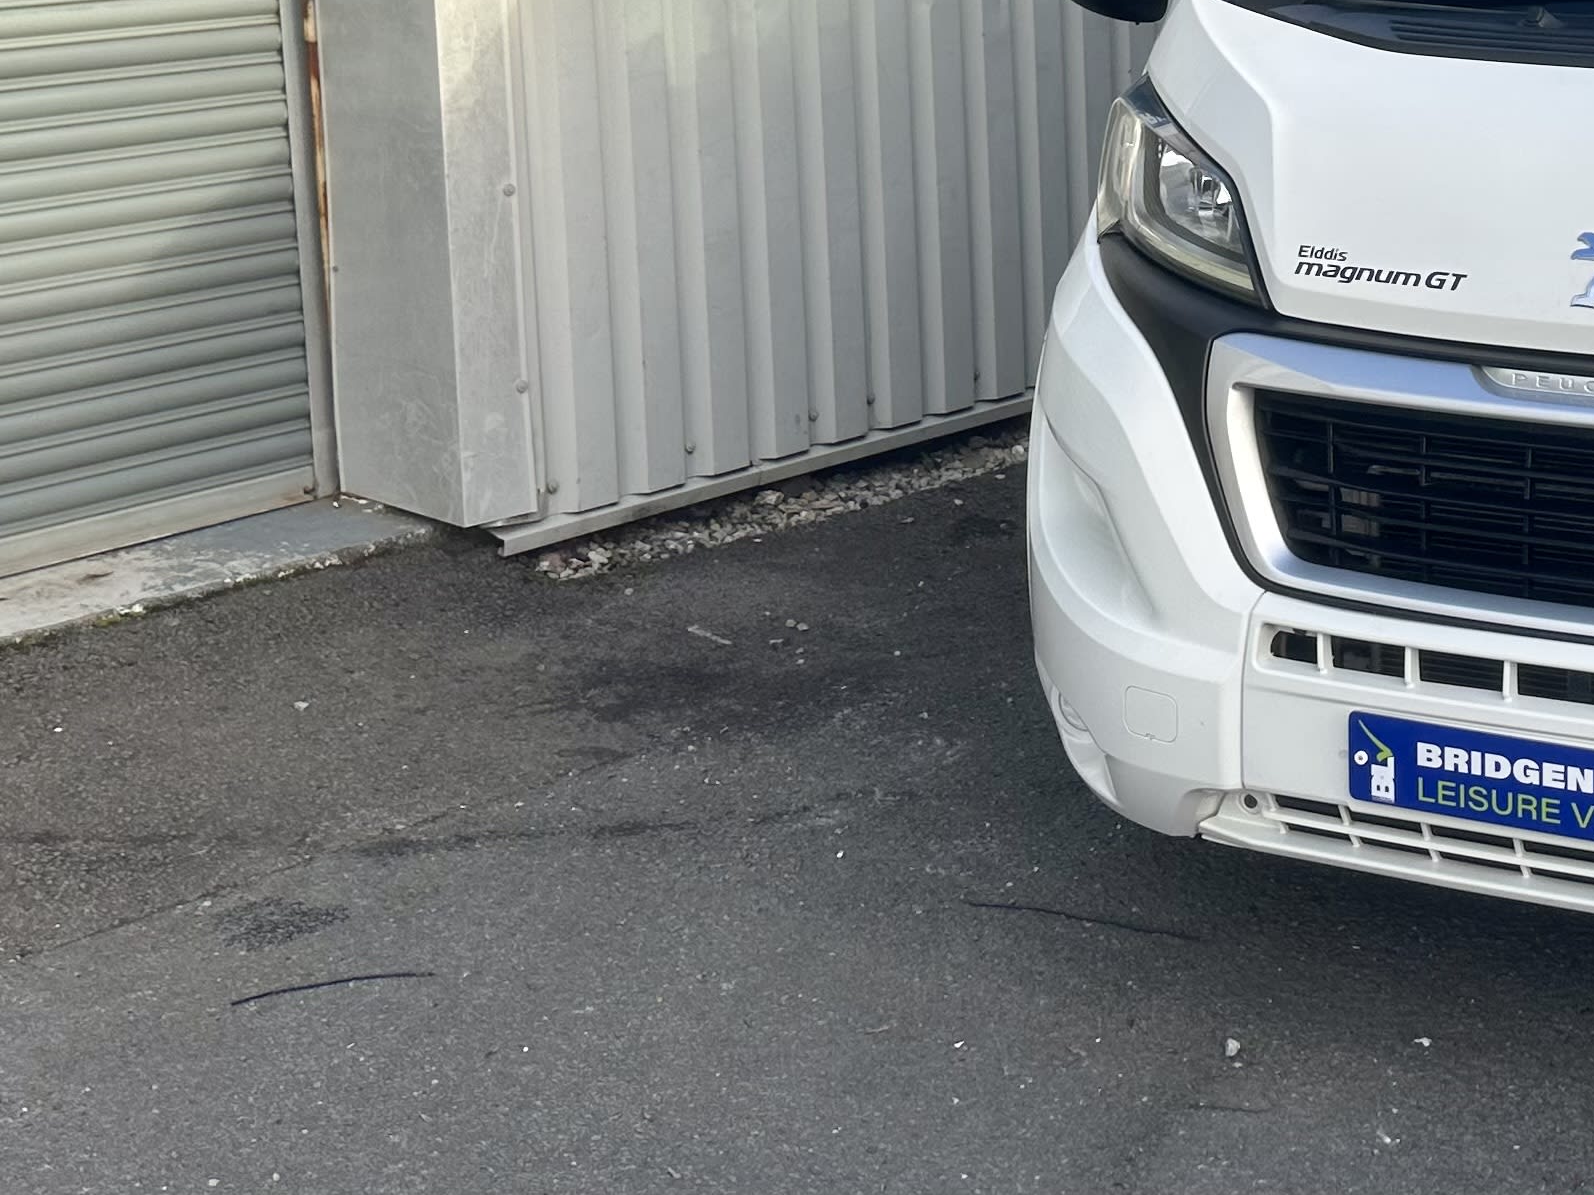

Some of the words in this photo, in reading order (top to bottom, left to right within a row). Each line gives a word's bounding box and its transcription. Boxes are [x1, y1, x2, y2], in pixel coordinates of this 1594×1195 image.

[1298, 244, 1348, 262] Elddis
[1294, 261, 1422, 287] magnum
[1425, 271, 1468, 291] GT
[1417, 777, 1561, 825] LEISURE
